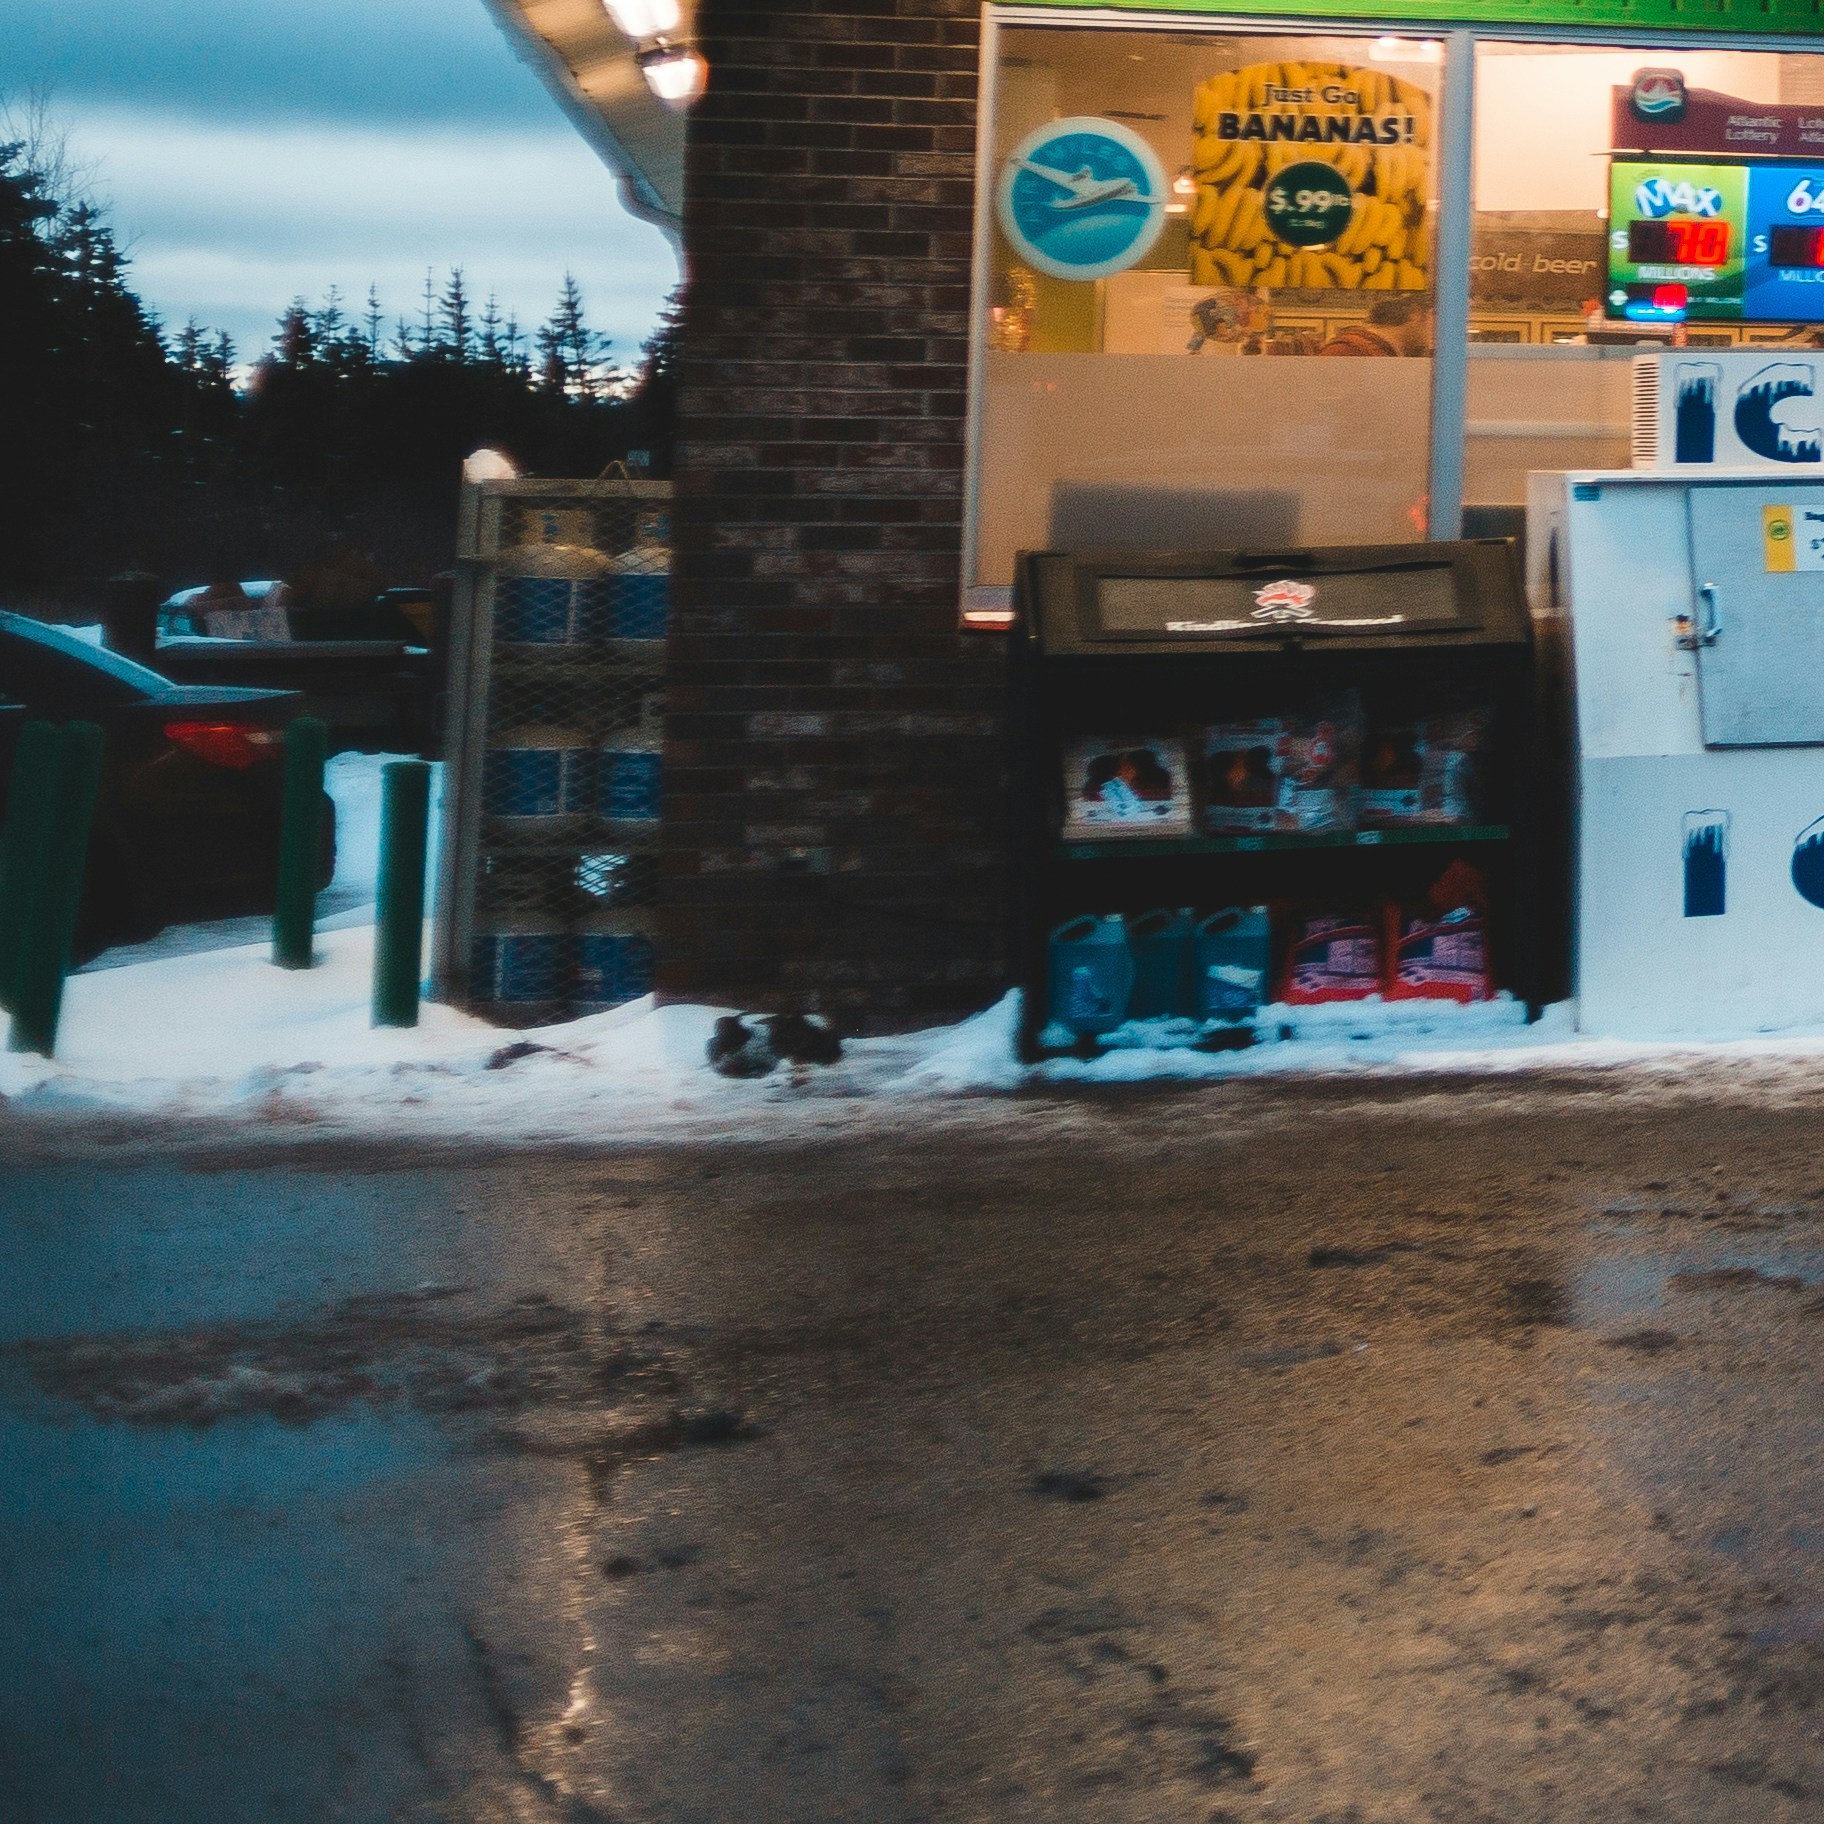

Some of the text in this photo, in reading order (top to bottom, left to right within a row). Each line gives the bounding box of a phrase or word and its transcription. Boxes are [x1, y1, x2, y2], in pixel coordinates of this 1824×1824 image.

[1262, 82, 1361, 108] Just Go
[1217, 111, 1416, 145] BANANAS!
[1727, 115, 1783, 129] Atlantic
[1726, 129, 1779, 145] Lottery
[1635, 177, 1723, 218] MAX
[1667, 219, 1731, 266] 70
[1531, 254, 1598, 275] beer
[1638, 265, 1717, 283] MILLIONS
